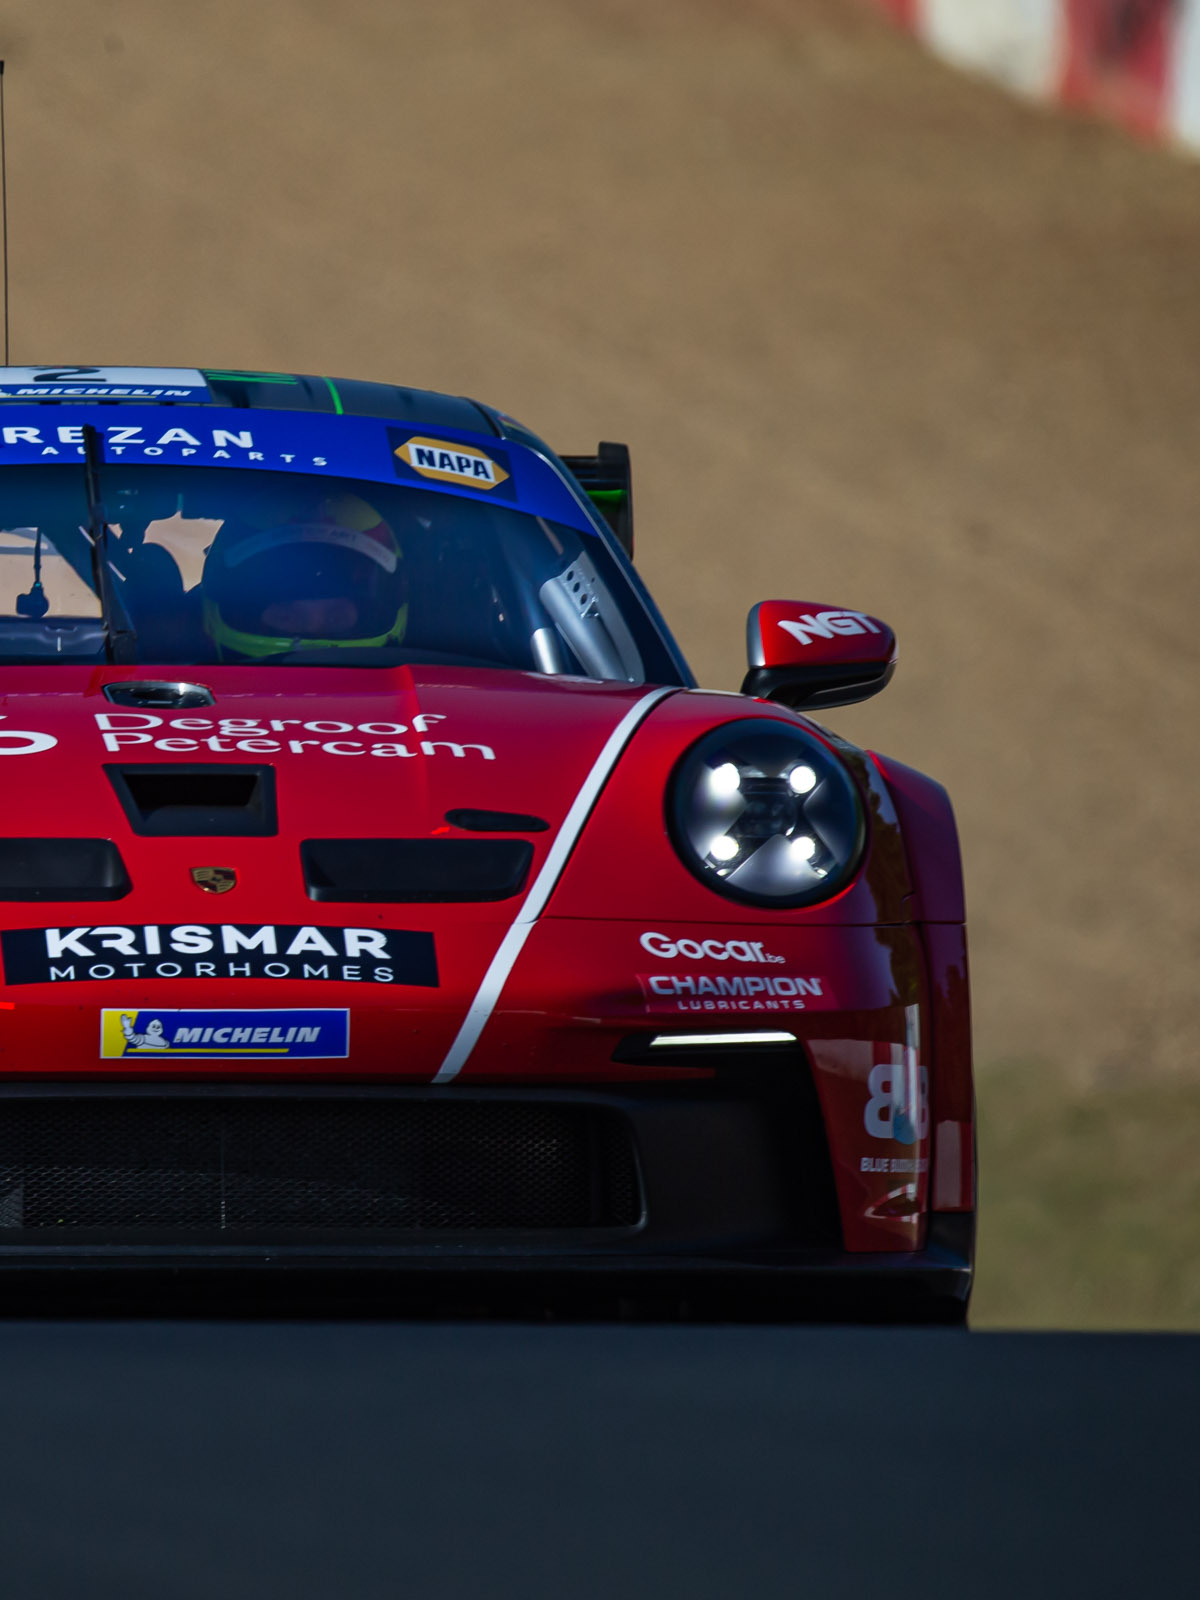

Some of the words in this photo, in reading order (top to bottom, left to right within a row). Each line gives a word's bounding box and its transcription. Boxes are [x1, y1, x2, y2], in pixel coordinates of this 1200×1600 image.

[29, 366, 107, 382] 2
[15, 387, 192, 398] MICHELIN
[415, 447, 491, 480] NAPA
[777, 611, 882, 645] NGT
[94, 712, 448, 737] Degroof
[101, 732, 497, 760] Petercam
[45, 925, 392, 959] KRISMAR
[50, 962, 395, 982] MOTORHOMES
[648, 975, 823, 996] CHAMPION
[677, 999, 806, 1011] LUBRICANTS
[173, 1026, 322, 1044] MICHELIN
